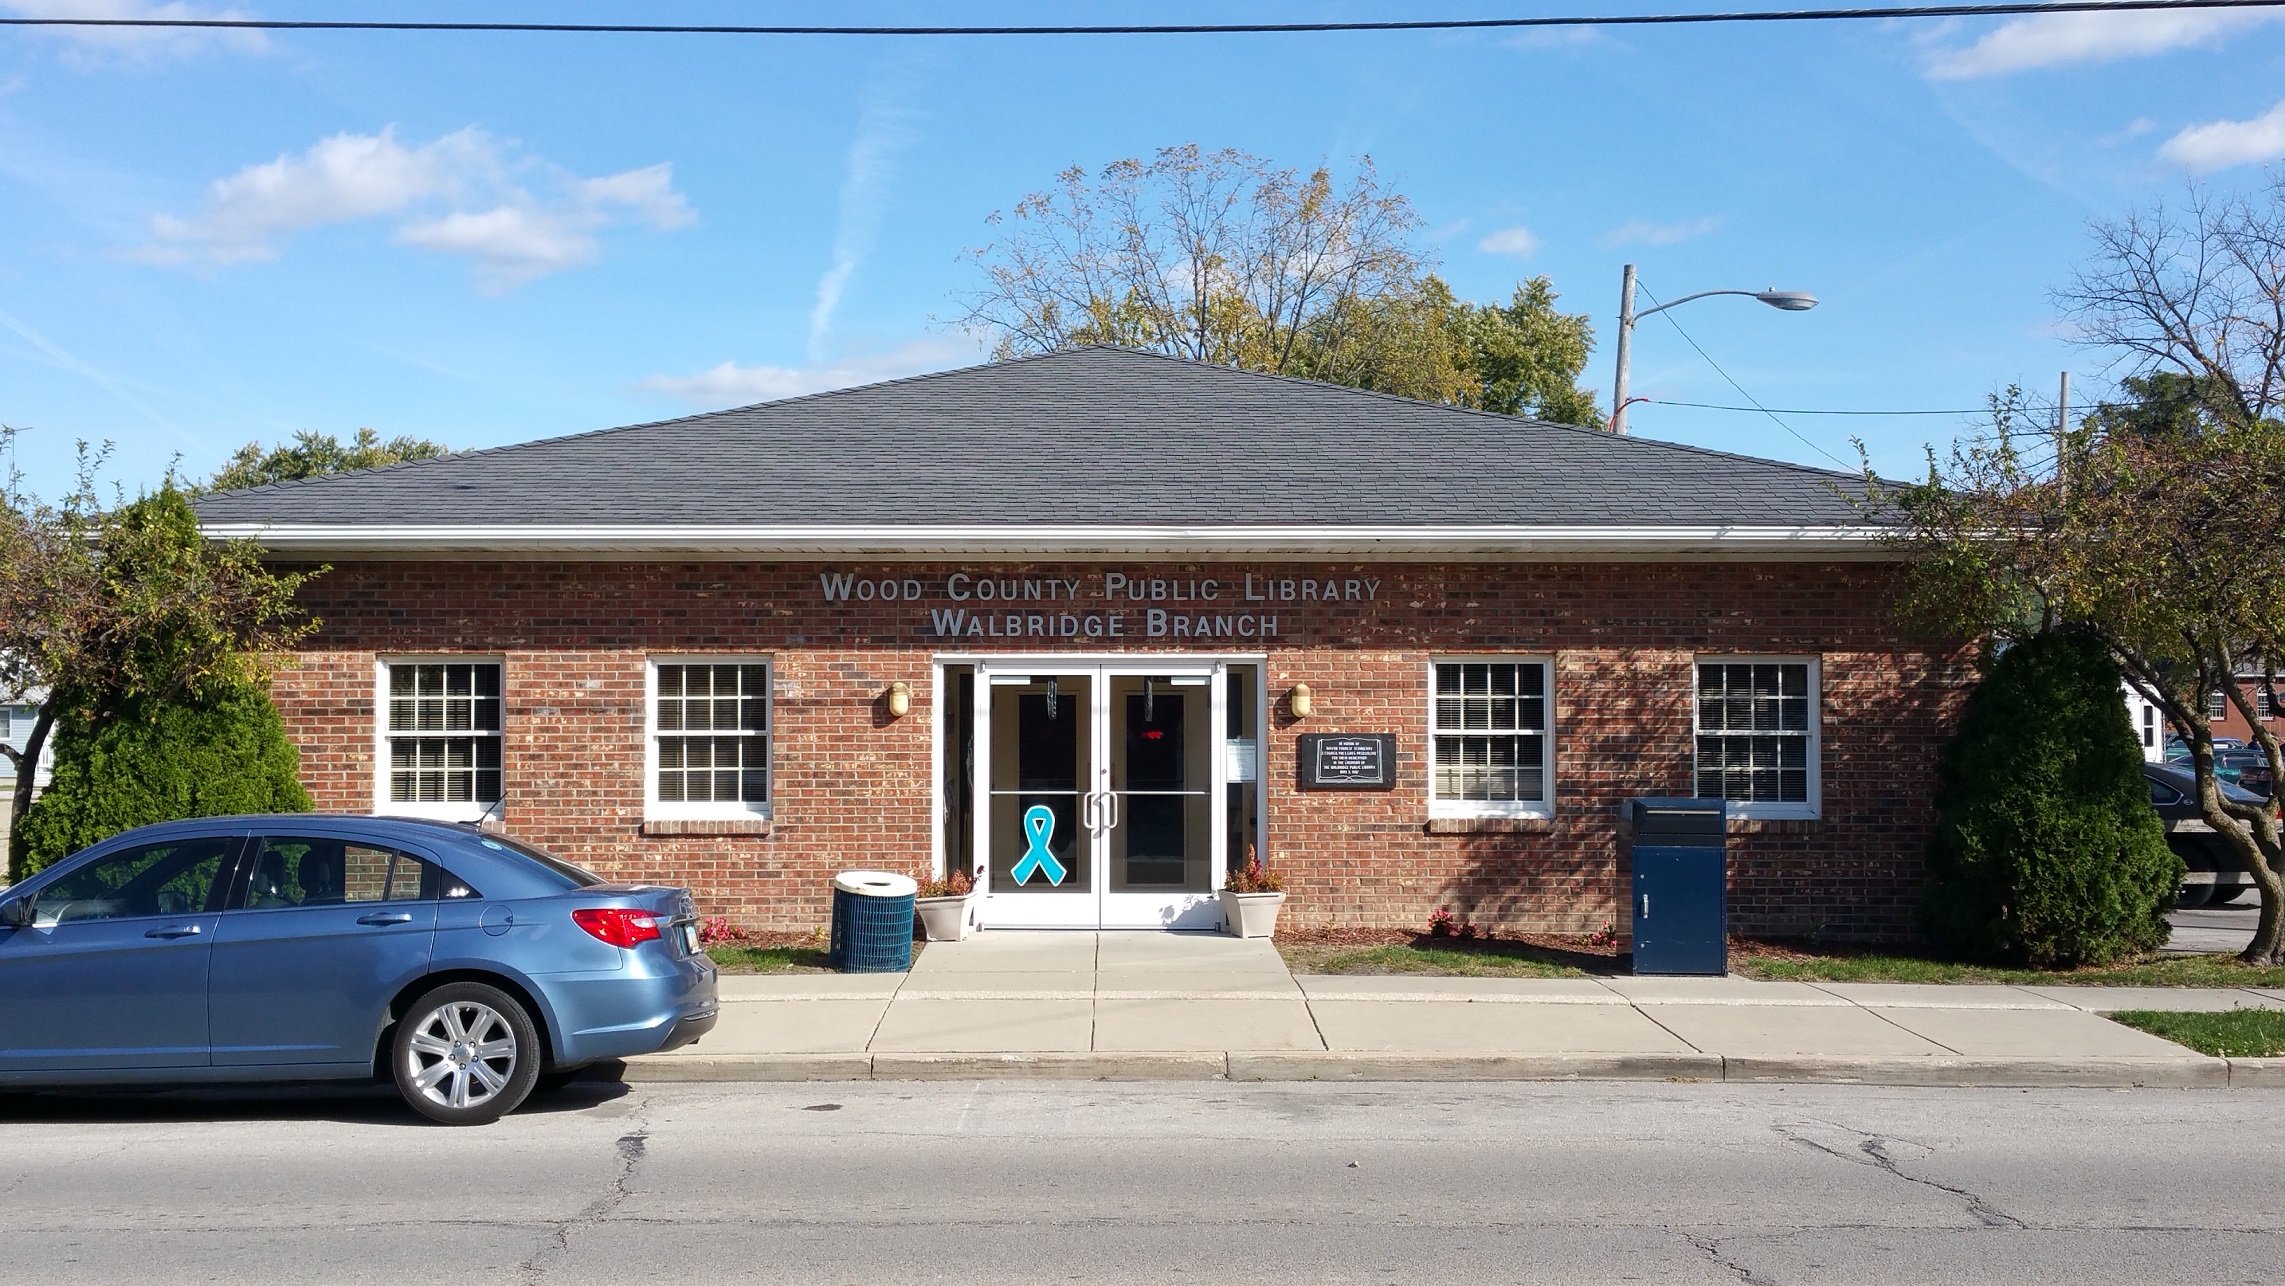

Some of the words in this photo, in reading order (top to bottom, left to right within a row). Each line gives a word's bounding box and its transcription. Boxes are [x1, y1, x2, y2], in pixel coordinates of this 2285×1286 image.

[819, 573, 922, 601] WOOD
[947, 573, 1081, 601] COUNTY
[1105, 572, 1219, 601] PUBLIC
[1245, 572, 1382, 601] LIBRARY
[931, 608, 1124, 637] WALBRIDGE
[1146, 608, 1278, 637] BRANCH
